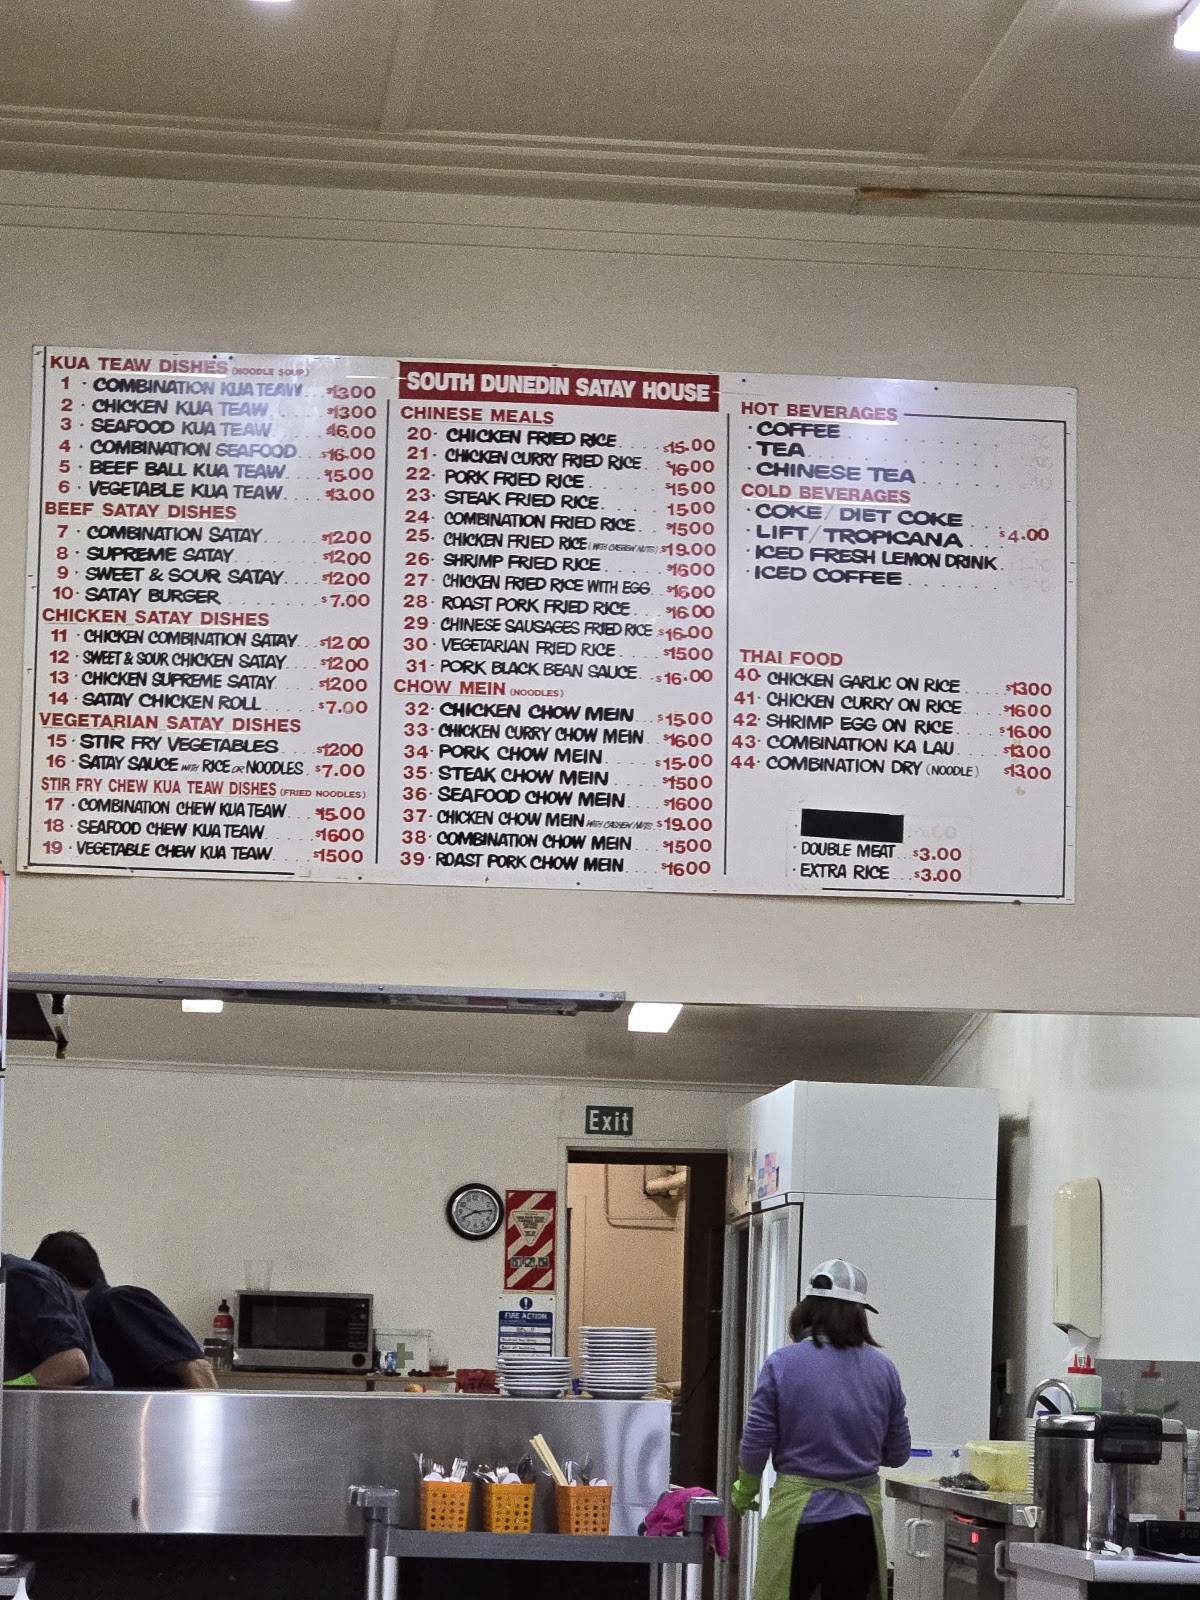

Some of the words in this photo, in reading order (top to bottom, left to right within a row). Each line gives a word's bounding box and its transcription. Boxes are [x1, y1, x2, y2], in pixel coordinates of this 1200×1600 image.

[51, 356, 89, 369] KUA
[99, 358, 150, 371] TEAW
[160, 359, 227, 373] DISHES
[407, 372, 474, 392] SOUTH
[481, 375, 569, 396] DUNEDIN
[576, 379, 635, 398] SATAY
[643, 382, 710, 402] HOUSE
[401, 406, 482, 420] CHINESE
[491, 410, 554, 424] MEALS
[741, 402, 778, 416] HOT
[787, 403, 897, 421] BEVERAGES
[407, 427, 431, 439] 20
[446, 429, 521, 444] CHICKEN
[527, 432, 575, 446] FRIED
[580, 434, 616, 447] RICE
[757, 422, 840, 438] COFFEE
[756, 441, 805, 457] TEA
[59, 461, 70, 472] 5
[90, 462, 137, 475] BEEF
[145, 463, 186, 477] BALL
[193, 463, 229, 477] KUA
[235, 465, 285, 479] TEAW
[756, 463, 861, 480] CHINESE
[867, 467, 915, 483] TEA
[59, 481, 69, 493] 6
[89, 482, 184, 497] VEGETABLE
[191, 484, 227, 498] KUA
[234, 485, 282, 499] TEAW
[741, 484, 791, 498] COLD
[800, 486, 911, 503] BEVERAGES
[45, 502, 93, 515] BEEF
[103, 503, 159, 518] SATAY
[168, 504, 236, 519] DISHES
[897, 511, 963, 526] COKE
[755, 546, 803, 559] ICED
[810, 548, 875, 563] FRESH
[882, 552, 940, 567] LEMON
[945, 554, 997, 570] DRINK
[404, 573, 428, 586] 27
[442, 574, 500, 590] CHICKEN
[505, 577, 546, 590] FRIED
[550, 579, 583, 592] RICE
[588, 580, 618, 594] WITH
[622, 581, 650, 594] EGG
[755, 566, 806, 580] ICED
[813, 569, 902, 585] COFFEE
[53, 587, 72, 599] 10
[85, 588, 142, 602] SATAY
[149, 589, 221, 604] BURGER
[42, 608, 126, 623] CHICKEN
[135, 611, 192, 625] SATAY
[200, 613, 269, 626] DISHES
[404, 616, 428, 629] 29
[441, 618, 500, 631] CHINESE
[505, 620, 580, 634] SAUSAGES
[584, 623, 622, 635] FRIED
[624, 624, 653, 636] RICE
[51, 629, 66, 642] 11
[84, 629, 143, 645] CHICKEN
[148, 632, 246, 646] COMBINATION
[250, 633, 297, 648] SATAY
[740, 650, 783, 664] THAI
[790, 652, 843, 666] FOOD
[406, 660, 427, 672] 31
[441, 661, 485, 675] PORK
[492, 662, 539, 676] BLACK
[544, 664, 582, 677] BEAN
[588, 665, 637, 679] SAUCE
[393, 679, 450, 693] CHOW
[460, 681, 505, 695] MEIN
[510, 688, 563, 697] (NOODLES)
[735, 668, 758, 681] 40
[767, 672, 833, 687] CHICKEN
[839, 675, 891, 690] GARLIC
[897, 678, 918, 691] ON
[924, 679, 960, 693] RICE
[49, 692, 68, 705] 14
[82, 693, 133, 707] SATAY
[139, 695, 212, 709] CHICKEN
[218, 696, 261, 711] ROLL
[734, 692, 755, 705] 41
[767, 692, 834, 708] CHICKEN
[840, 696, 893, 710] CURRY
[898, 699, 920, 711] ON
[925, 700, 962, 714] RICE
[40, 713, 158, 729] VEGETARIAN
[167, 716, 223, 731] SATAY
[233, 718, 301, 733] DISHES
[733, 714, 757, 726] 42
[766, 714, 833, 729] SHRIMP
[840, 717, 877, 731] EGG
[882, 719, 906, 732] ON
[915, 720, 953, 734] RICE
[404, 724, 428, 736] 33
[438, 725, 500, 739] CHICKEN
[505, 726, 551, 740] CURRY
[555, 728, 598, 742] CHOW
[603, 729, 643, 744] MEIN
[47, 735, 66, 747] 15
[80, 735, 124, 749] STIR
[131, 735, 161, 750] FRY
[167, 737, 278, 753] VEGETABLES
[731, 736, 756, 749] 43
[767, 736, 888, 752] COMBINATION
[894, 739, 917, 753] KA
[923, 741, 954, 755] LAU
[46, 755, 66, 768] 16
[79, 755, 124, 770] SATAY
[128, 756, 178, 772] SAUCE
[202, 759, 230, 773] RICE
[246, 760, 303, 774] NOODLES
[731, 756, 755, 769] 44
[767, 756, 885, 773] COMBINATION
[891, 760, 923, 775] DRY
[926, 765, 979, 778] (NOODLE)
[41, 778, 70, 791] STIR
[76, 779, 101, 792] FRY
[109, 779, 147, 793] CHEW
[154, 780, 180, 794] KUA
[188, 782, 223, 795] TEAW
[230, 782, 276, 796] DISHES
[280, 790, 311, 798] (FRIED
[316, 791, 365, 799] NOODLES)
[43, 841, 63, 854] 19
[77, 842, 150, 857] VEGETABLE
[155, 844, 195, 859] CHEW
[201, 846, 225, 859] KUA
[231, 847, 272, 860] TEAW
[801, 842, 850, 856] DOUBLE
[857, 844, 895, 857] MEAT
[400, 853, 424, 865] 39
[436, 854, 483, 867] ROAST
[488, 855, 527, 869] PORK
[531, 857, 579, 870] CHOW
[584, 859, 624, 872] MEIN
[800, 864, 846, 879] EXTRA
[854, 866, 889, 879] RICE
[589, 1110, 629, 1132] Exit
